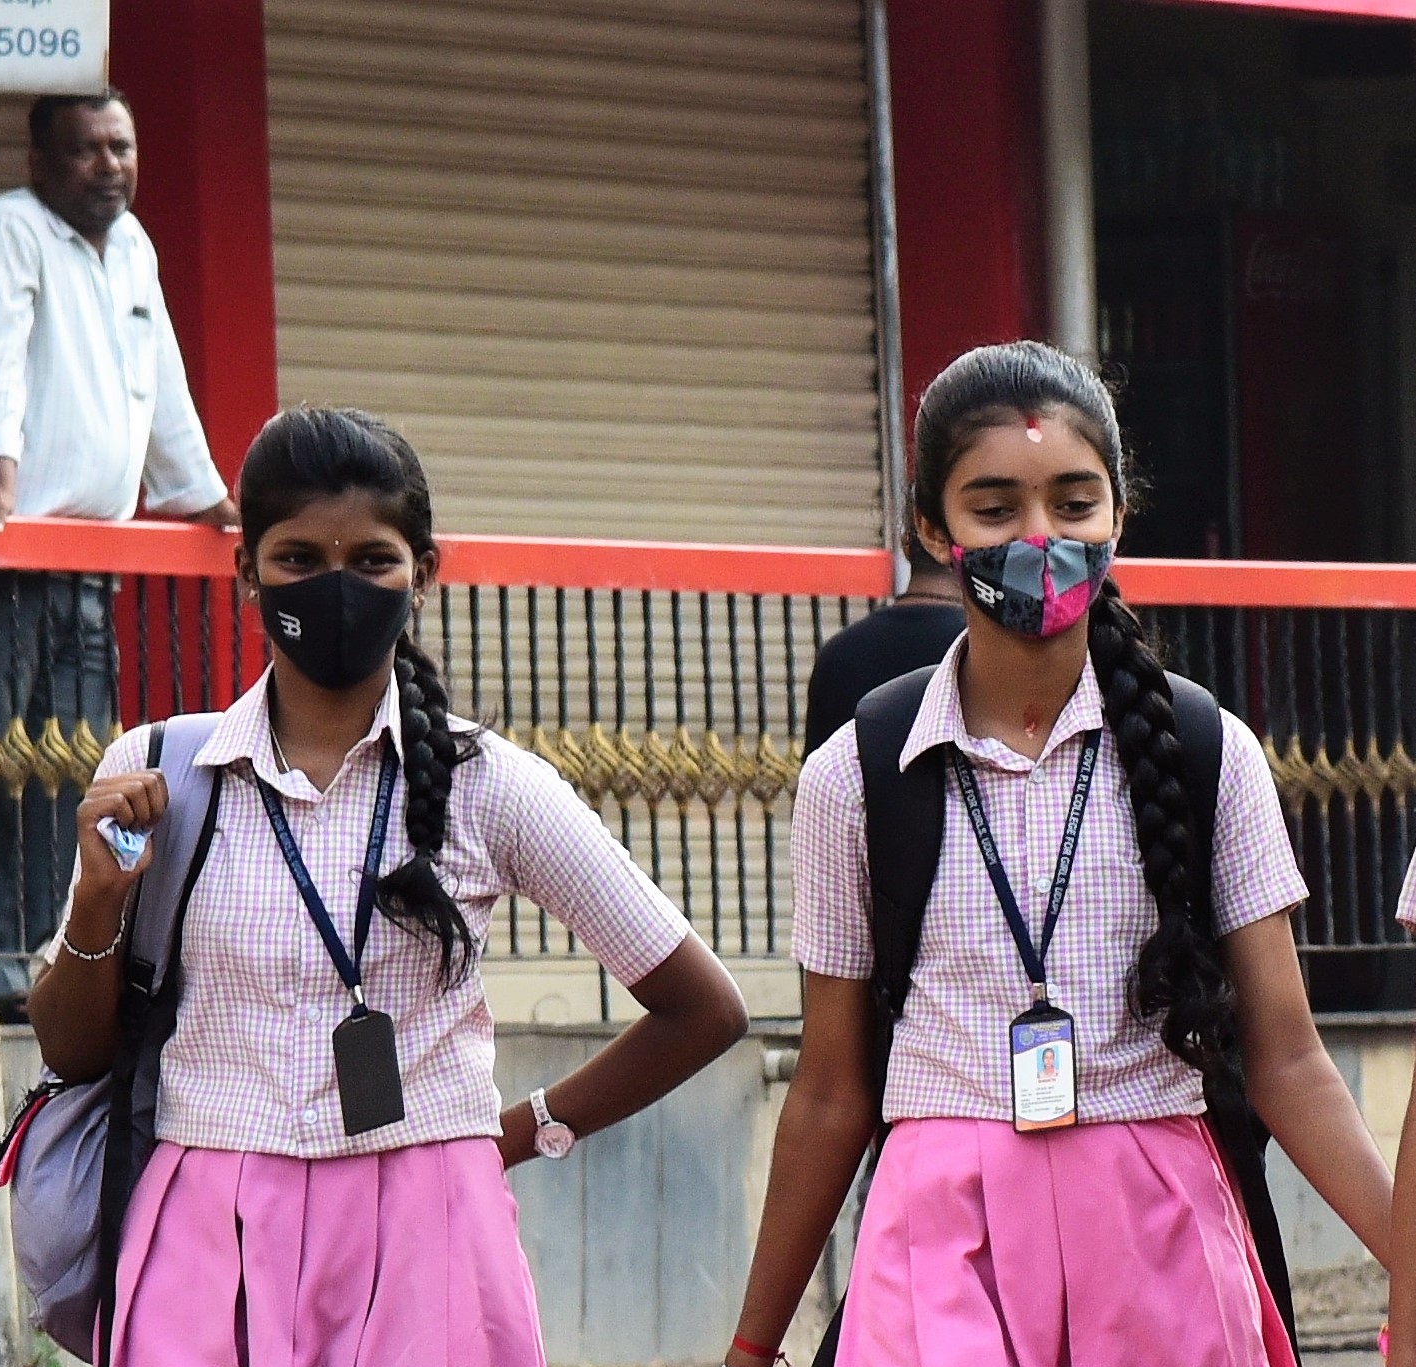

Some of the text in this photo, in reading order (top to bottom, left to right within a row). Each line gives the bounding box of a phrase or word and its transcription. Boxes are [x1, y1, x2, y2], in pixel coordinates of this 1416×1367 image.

[965, 789, 978, 809] FOR
[981, 837, 998, 866] UDUPI
[1066, 794, 1084, 836] COLLEGE
[1062, 836, 1075, 856] FOR
[1050, 886, 1064, 915] UDUPI
